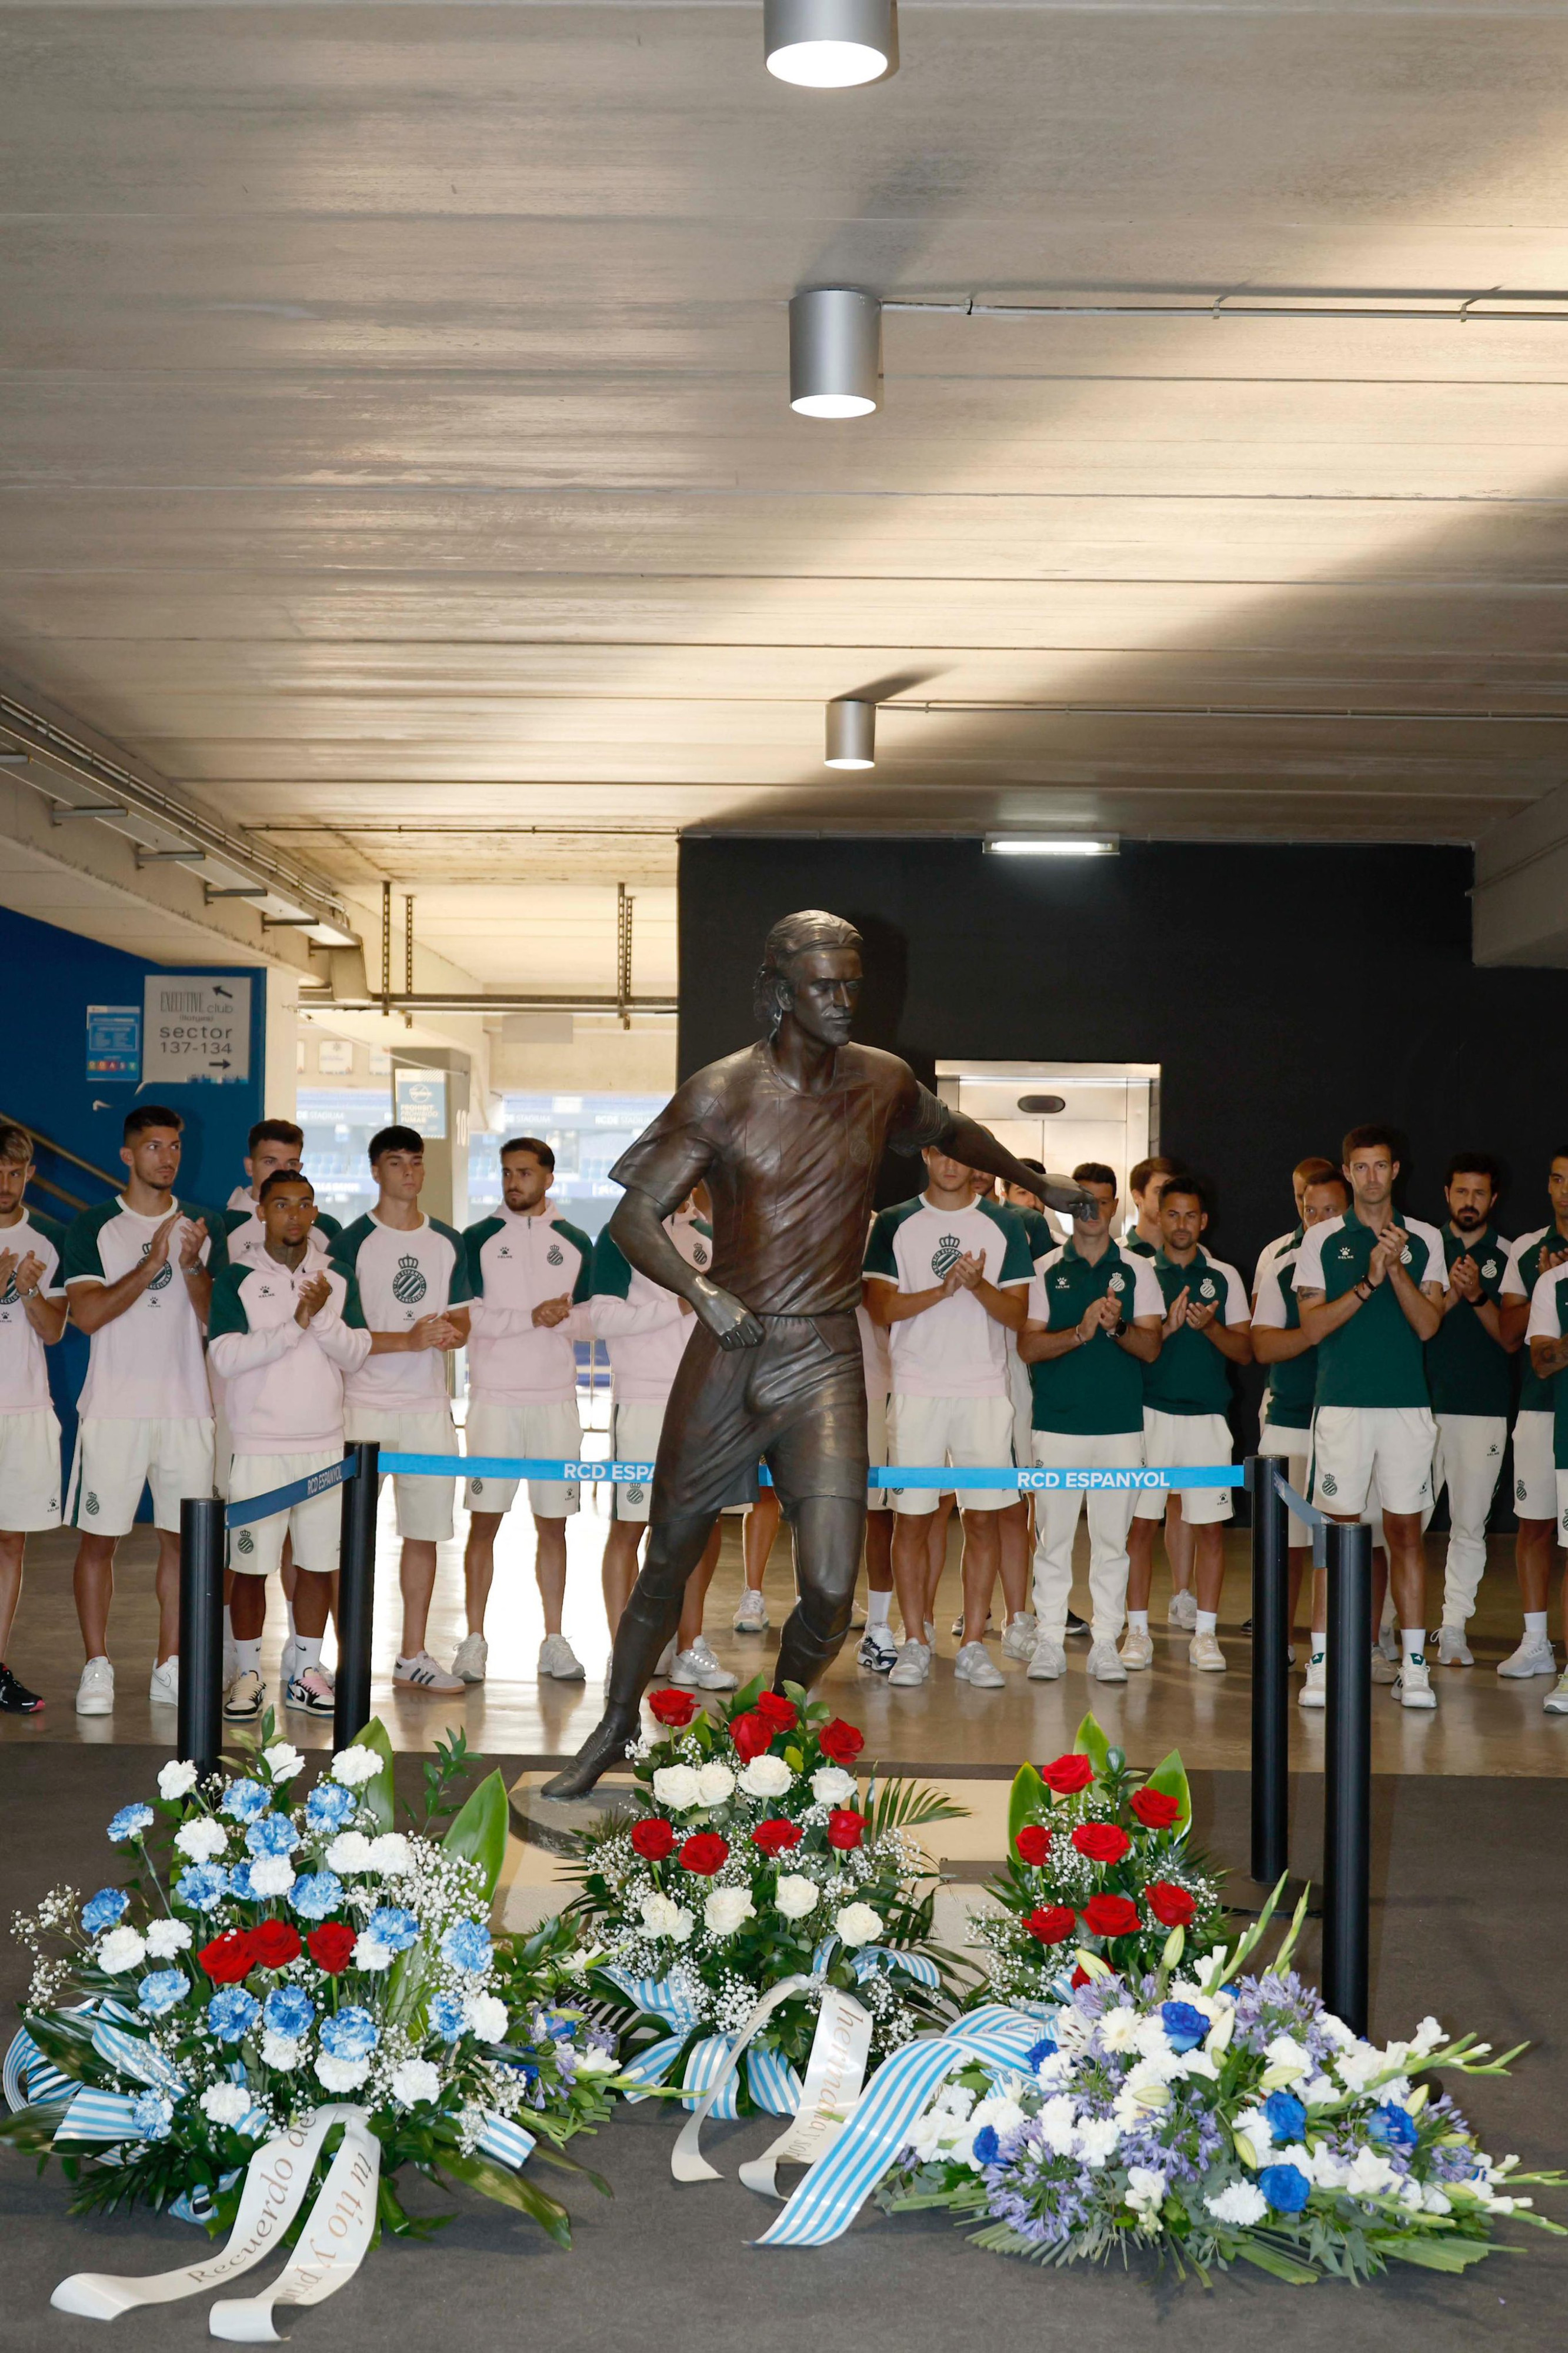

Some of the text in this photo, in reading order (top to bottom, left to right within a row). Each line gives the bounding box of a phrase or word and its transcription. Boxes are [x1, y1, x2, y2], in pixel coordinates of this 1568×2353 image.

[207, 1002, 233, 1013] club
[159, 1026, 232, 1039] sector
[161, 1041, 232, 1055] 137-134
[307, 1464, 342, 1496] RCD ESPANYOL
[564, 1463, 606, 1479] RCD
[1017, 1471, 1170, 1488] RCD ESPANYOL
[351, 2152, 373, 2188] tu
[187, 2116, 316, 2283] Recuerdo de
[328, 2190, 363, 2238] tío
[309, 2238, 337, 2268] y
